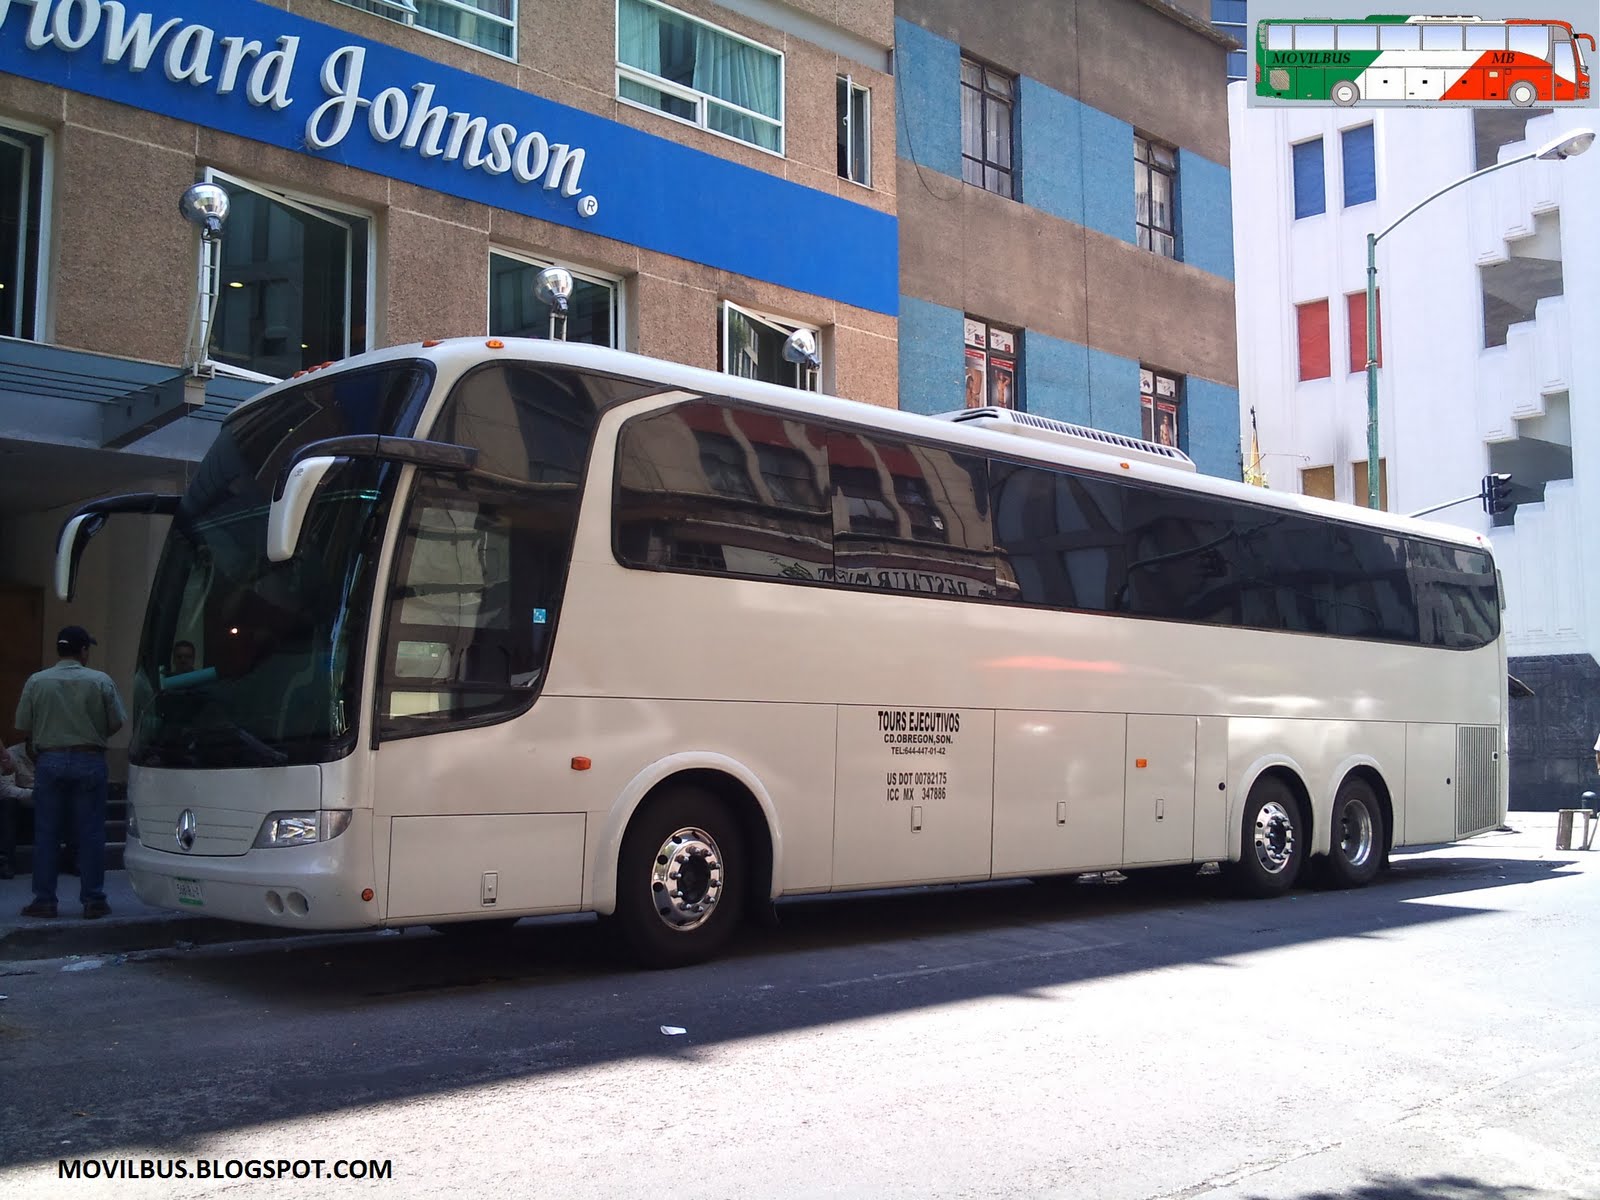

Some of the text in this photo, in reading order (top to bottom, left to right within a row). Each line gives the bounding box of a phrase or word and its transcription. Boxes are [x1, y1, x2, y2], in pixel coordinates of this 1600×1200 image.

[305, 45, 588, 197] Johnson
[878, 711, 960, 732] TOURS EJECUTIVOS
[886, 773, 897, 785] US
[899, 773, 913, 785] DOT
[887, 788, 900, 801] ICC
[903, 788, 914, 800] MX
